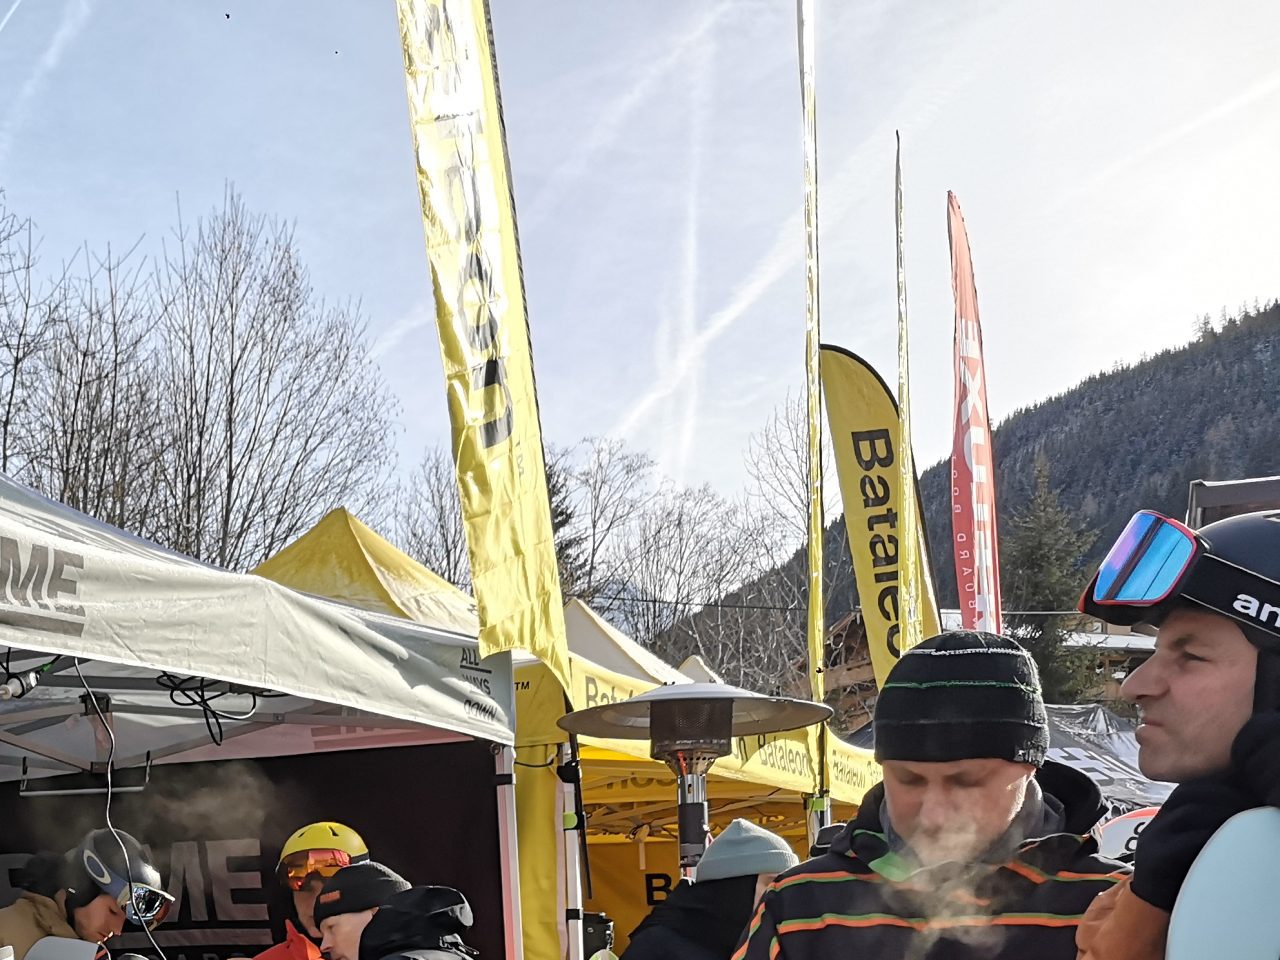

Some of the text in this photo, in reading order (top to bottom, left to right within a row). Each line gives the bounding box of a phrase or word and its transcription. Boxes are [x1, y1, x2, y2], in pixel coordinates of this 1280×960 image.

[851, 428, 901, 659] Bataleo
[460, 647, 480, 666] ALL
[758, 734, 812, 777] Bataleon
